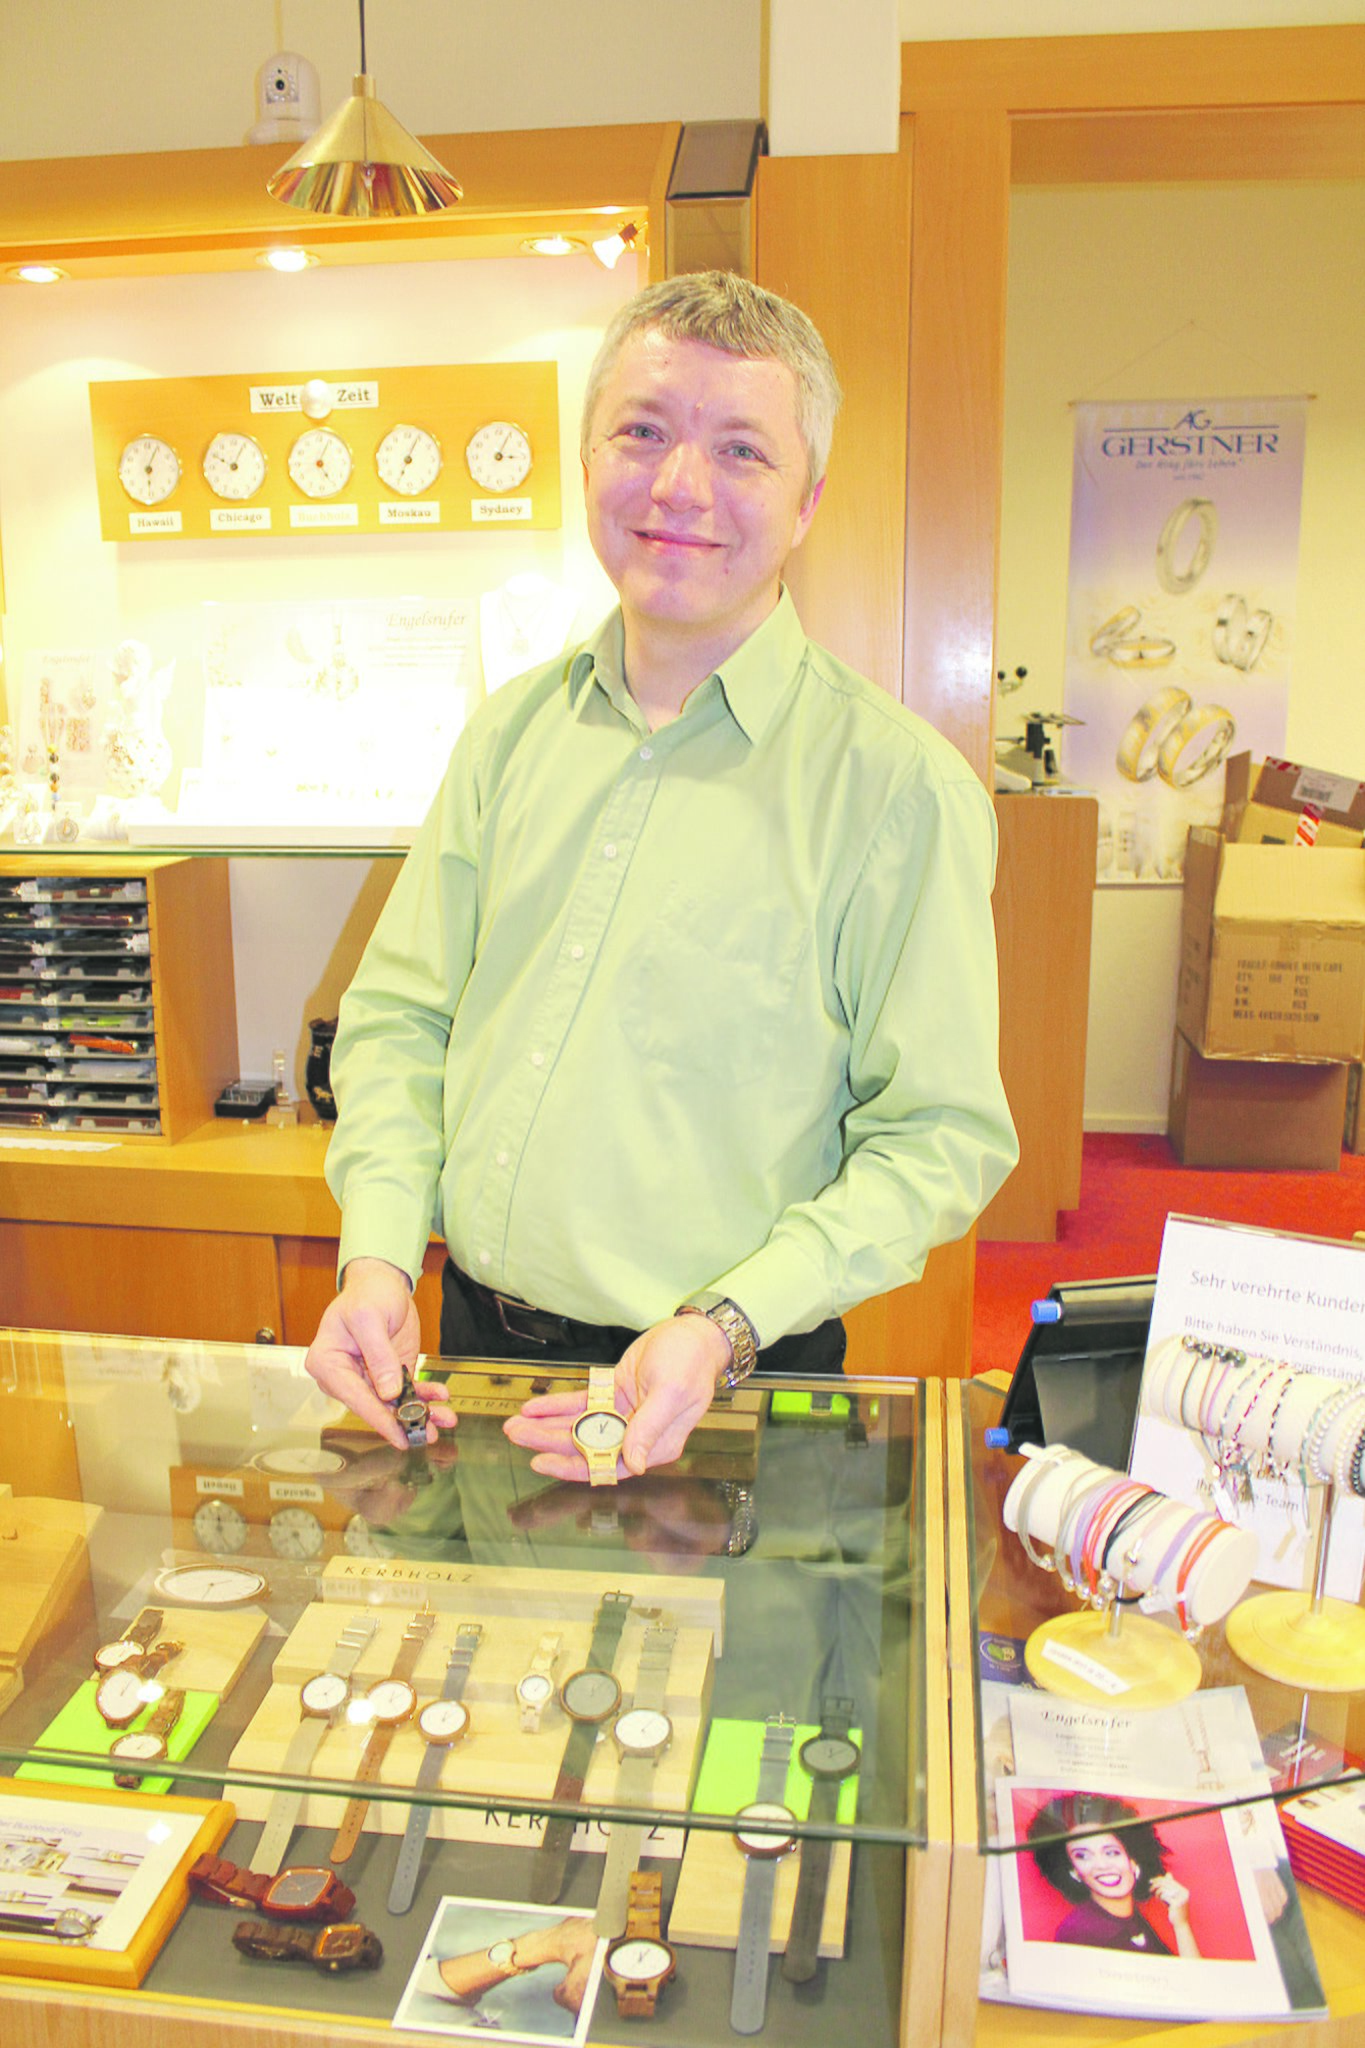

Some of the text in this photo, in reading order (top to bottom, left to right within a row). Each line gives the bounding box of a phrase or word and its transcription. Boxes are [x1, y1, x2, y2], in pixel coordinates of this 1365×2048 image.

[260, 388, 370, 406] Welt Zeit
[1101, 433, 1280, 458] GERSTNER
[217, 512, 263, 524] Chicago
[387, 508, 432, 518] Moskau
[480, 504, 523, 515] Sydney
[136, 517, 175, 528] Hawaii
[385, 609, 467, 631] Engelsrufer
[1190, 1270, 1226, 1289] Sehr
[1231, 1280, 1302, 1303] verehrte
[1184, 1315, 1214, 1331] Bitte
[1217, 1321, 1257, 1339] haben
[1260, 1329, 1279, 1341] Sie
[344, 1565, 474, 1584] KERBHOLZ
[1041, 1711, 1132, 1729] Engelsrufer
